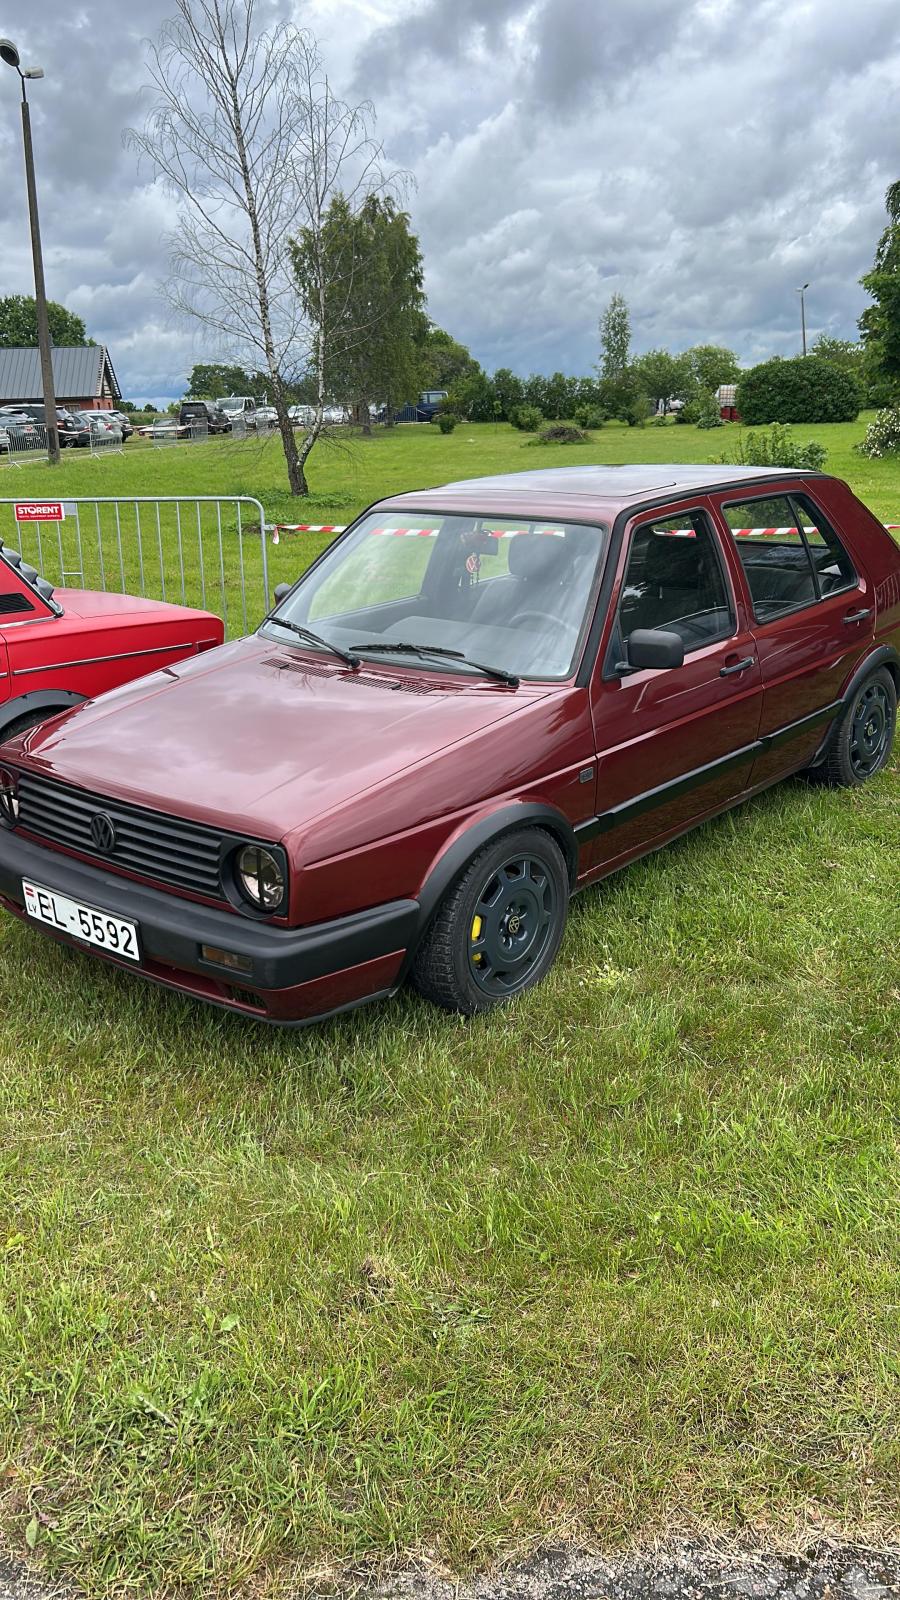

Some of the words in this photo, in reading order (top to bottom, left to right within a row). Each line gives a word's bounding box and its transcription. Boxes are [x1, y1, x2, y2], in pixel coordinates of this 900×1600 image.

[17, 506, 59, 514] STORENT
[91, 814, 114, 851] VW
[27, 902, 37, 914] LV
[37, 891, 135, 956] EL-5592
